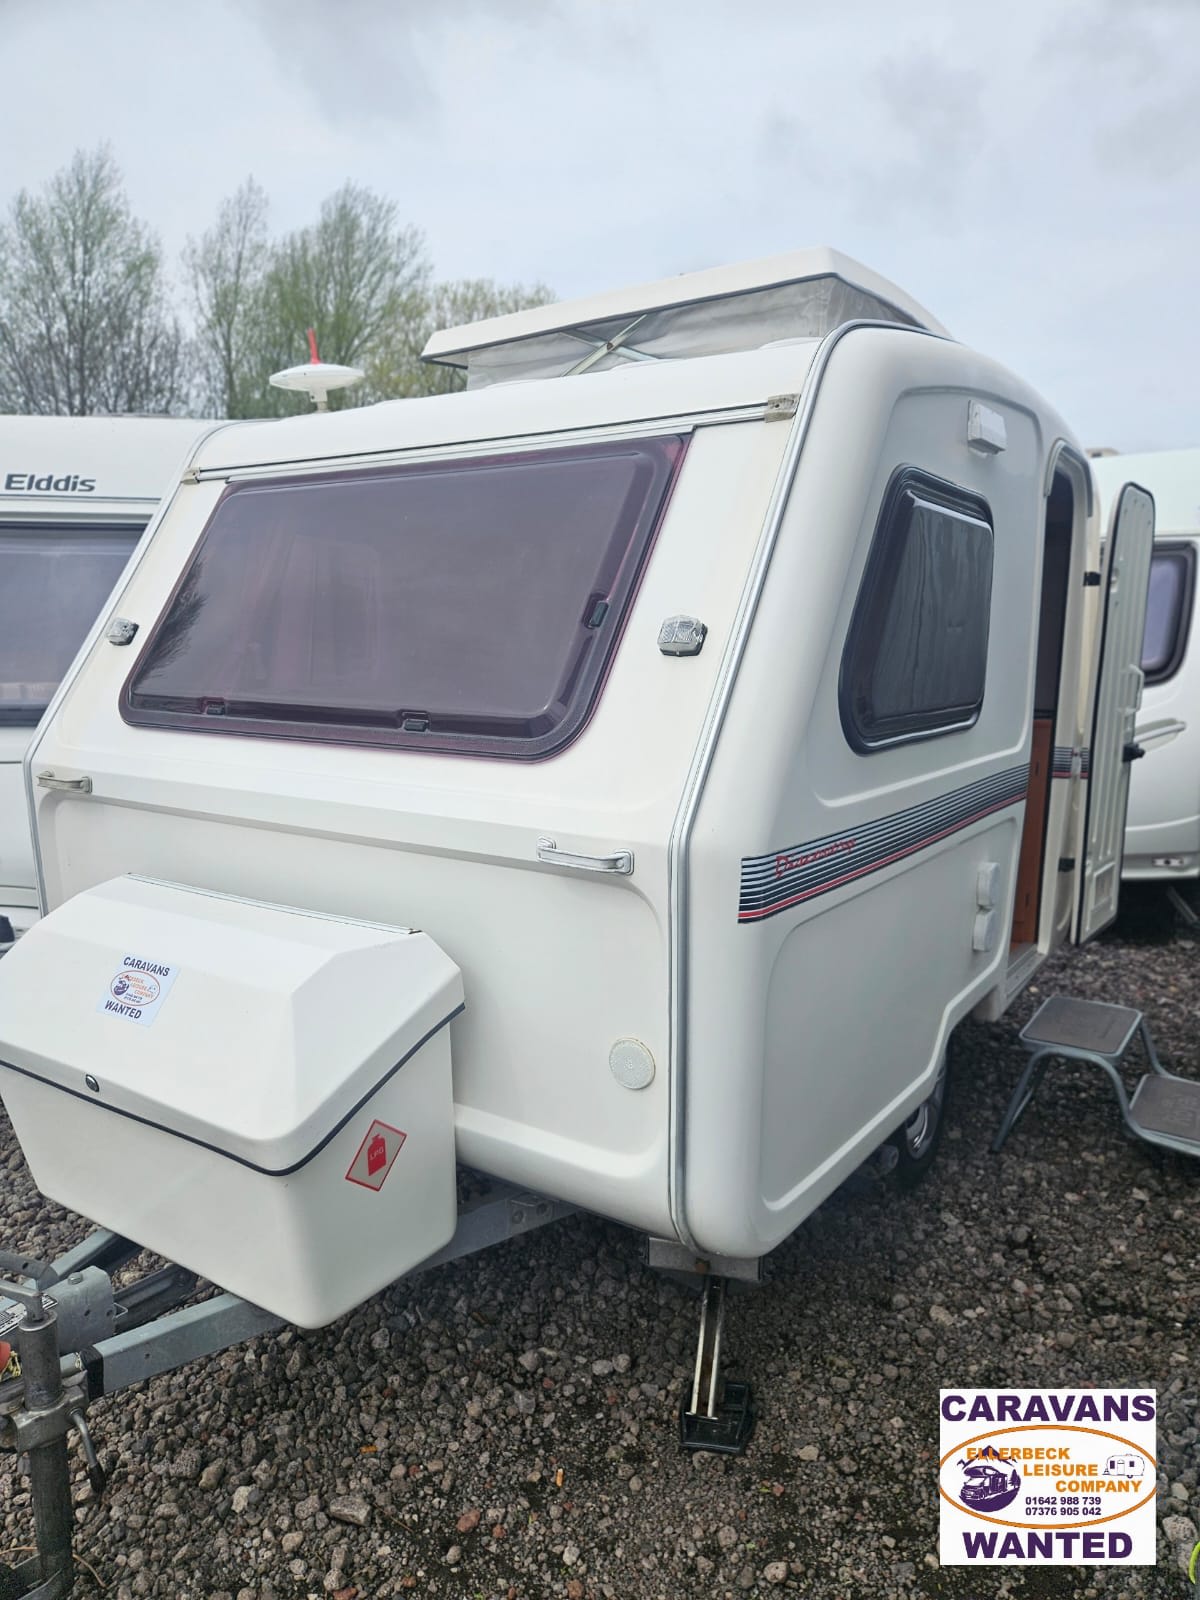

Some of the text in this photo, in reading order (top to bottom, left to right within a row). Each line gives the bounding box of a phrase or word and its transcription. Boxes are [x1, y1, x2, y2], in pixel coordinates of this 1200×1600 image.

[5, 473, 96, 492] Elddis
[123, 956, 170, 977] CARAVANS
[104, 1000, 142, 1019] WANTED
